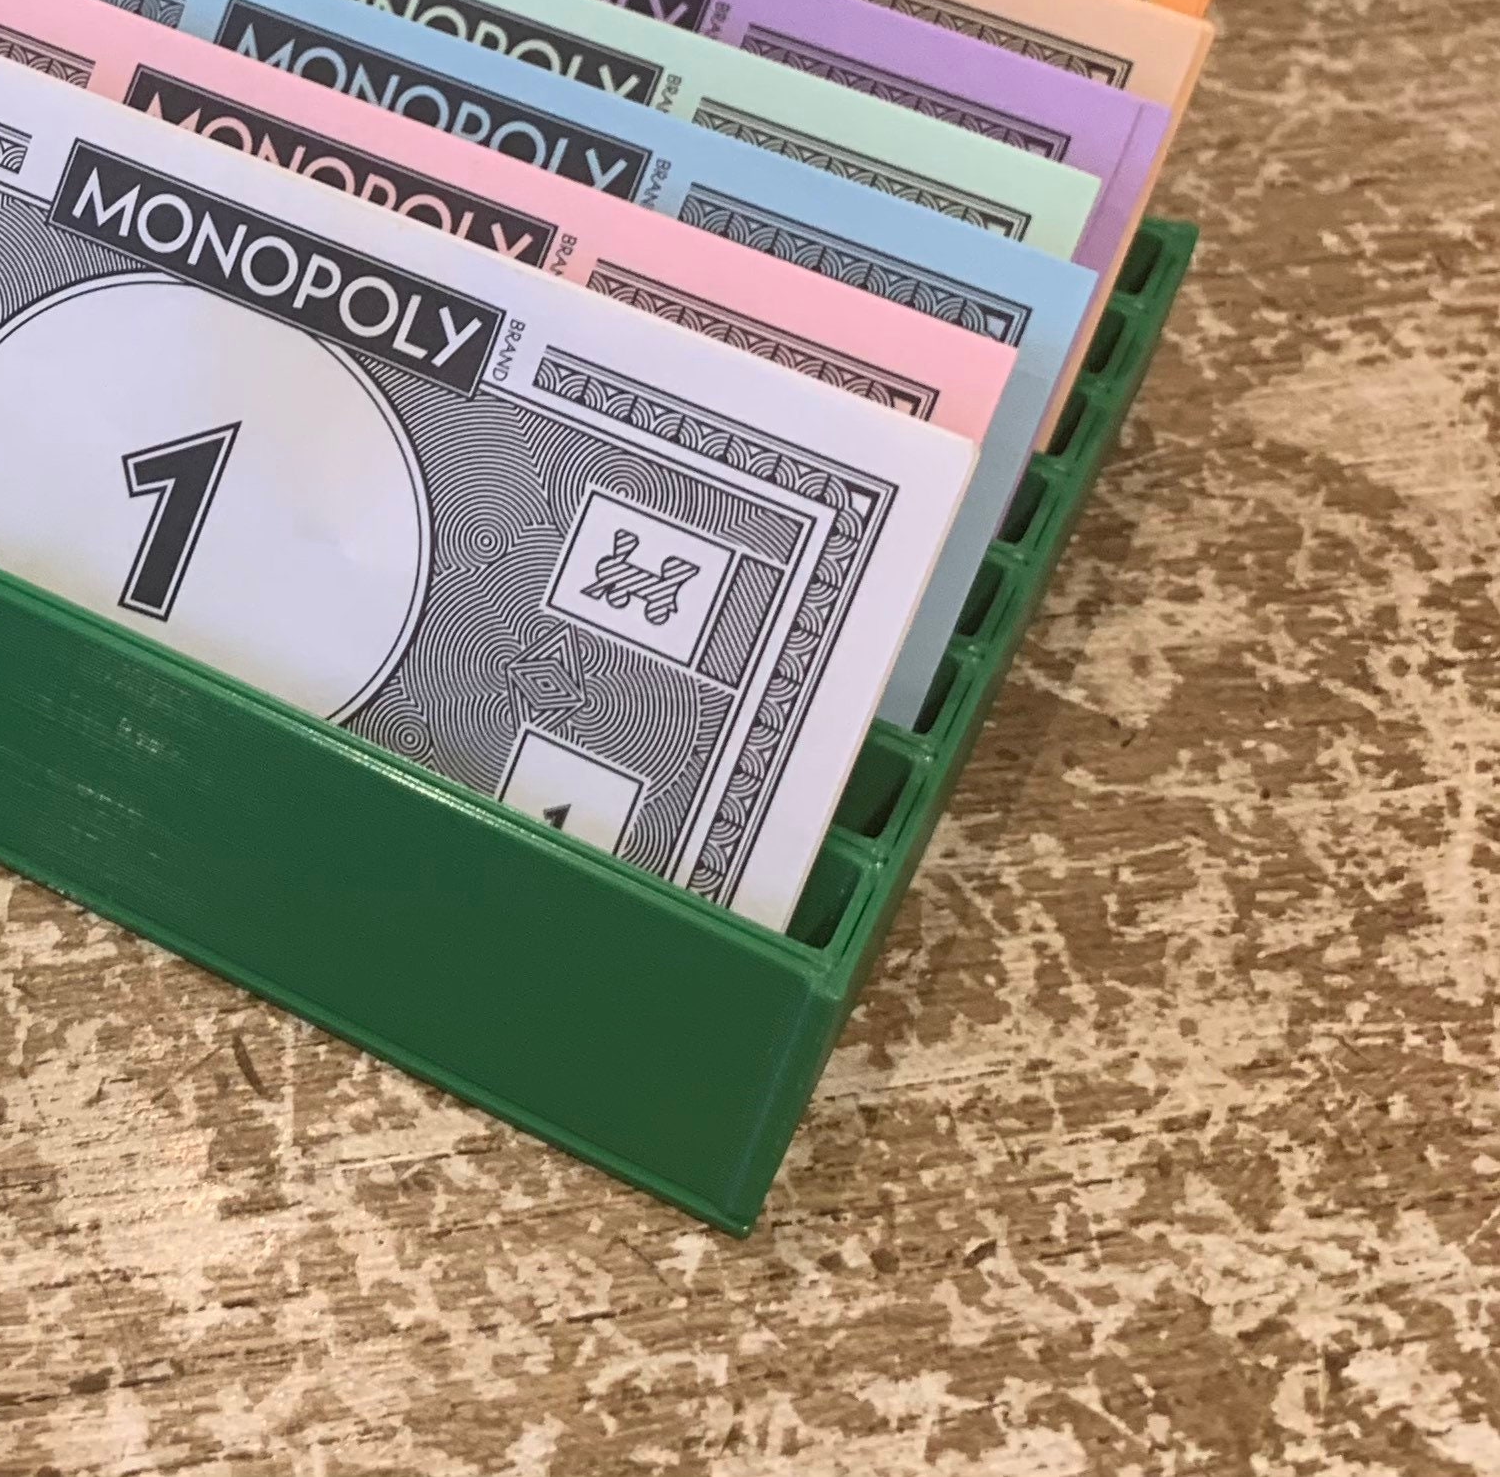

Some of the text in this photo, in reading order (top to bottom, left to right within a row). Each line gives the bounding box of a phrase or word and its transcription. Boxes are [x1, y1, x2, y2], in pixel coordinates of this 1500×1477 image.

[235, 24, 672, 209] MONOPOLY BRAN
[656, 74, 682, 113] BRA
[72, 167, 526, 382] MONOPOLY BRAND
[550, 233, 577, 275] BRA
[119, 422, 242, 621] 1
